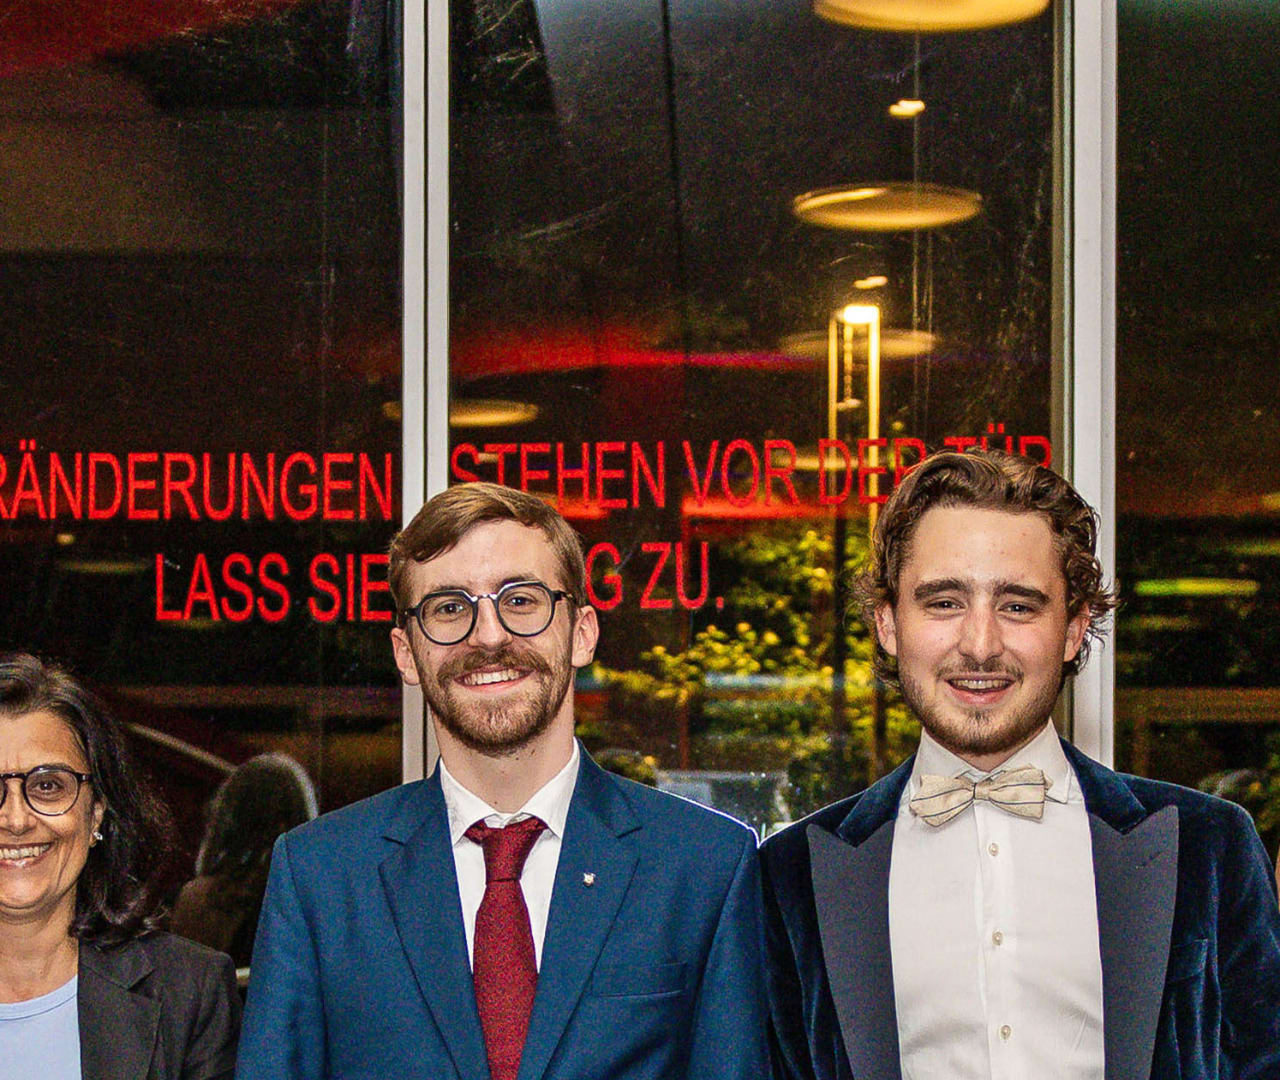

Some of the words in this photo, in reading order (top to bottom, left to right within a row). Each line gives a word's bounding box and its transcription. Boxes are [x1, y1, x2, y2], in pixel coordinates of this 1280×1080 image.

[451, 441, 665, 508] STEHEN
[682, 439, 798, 504] VOR
[156, 552, 290, 622] LASS
[308, 552, 392, 622] SIE
[641, 542, 725, 610] ZU.
